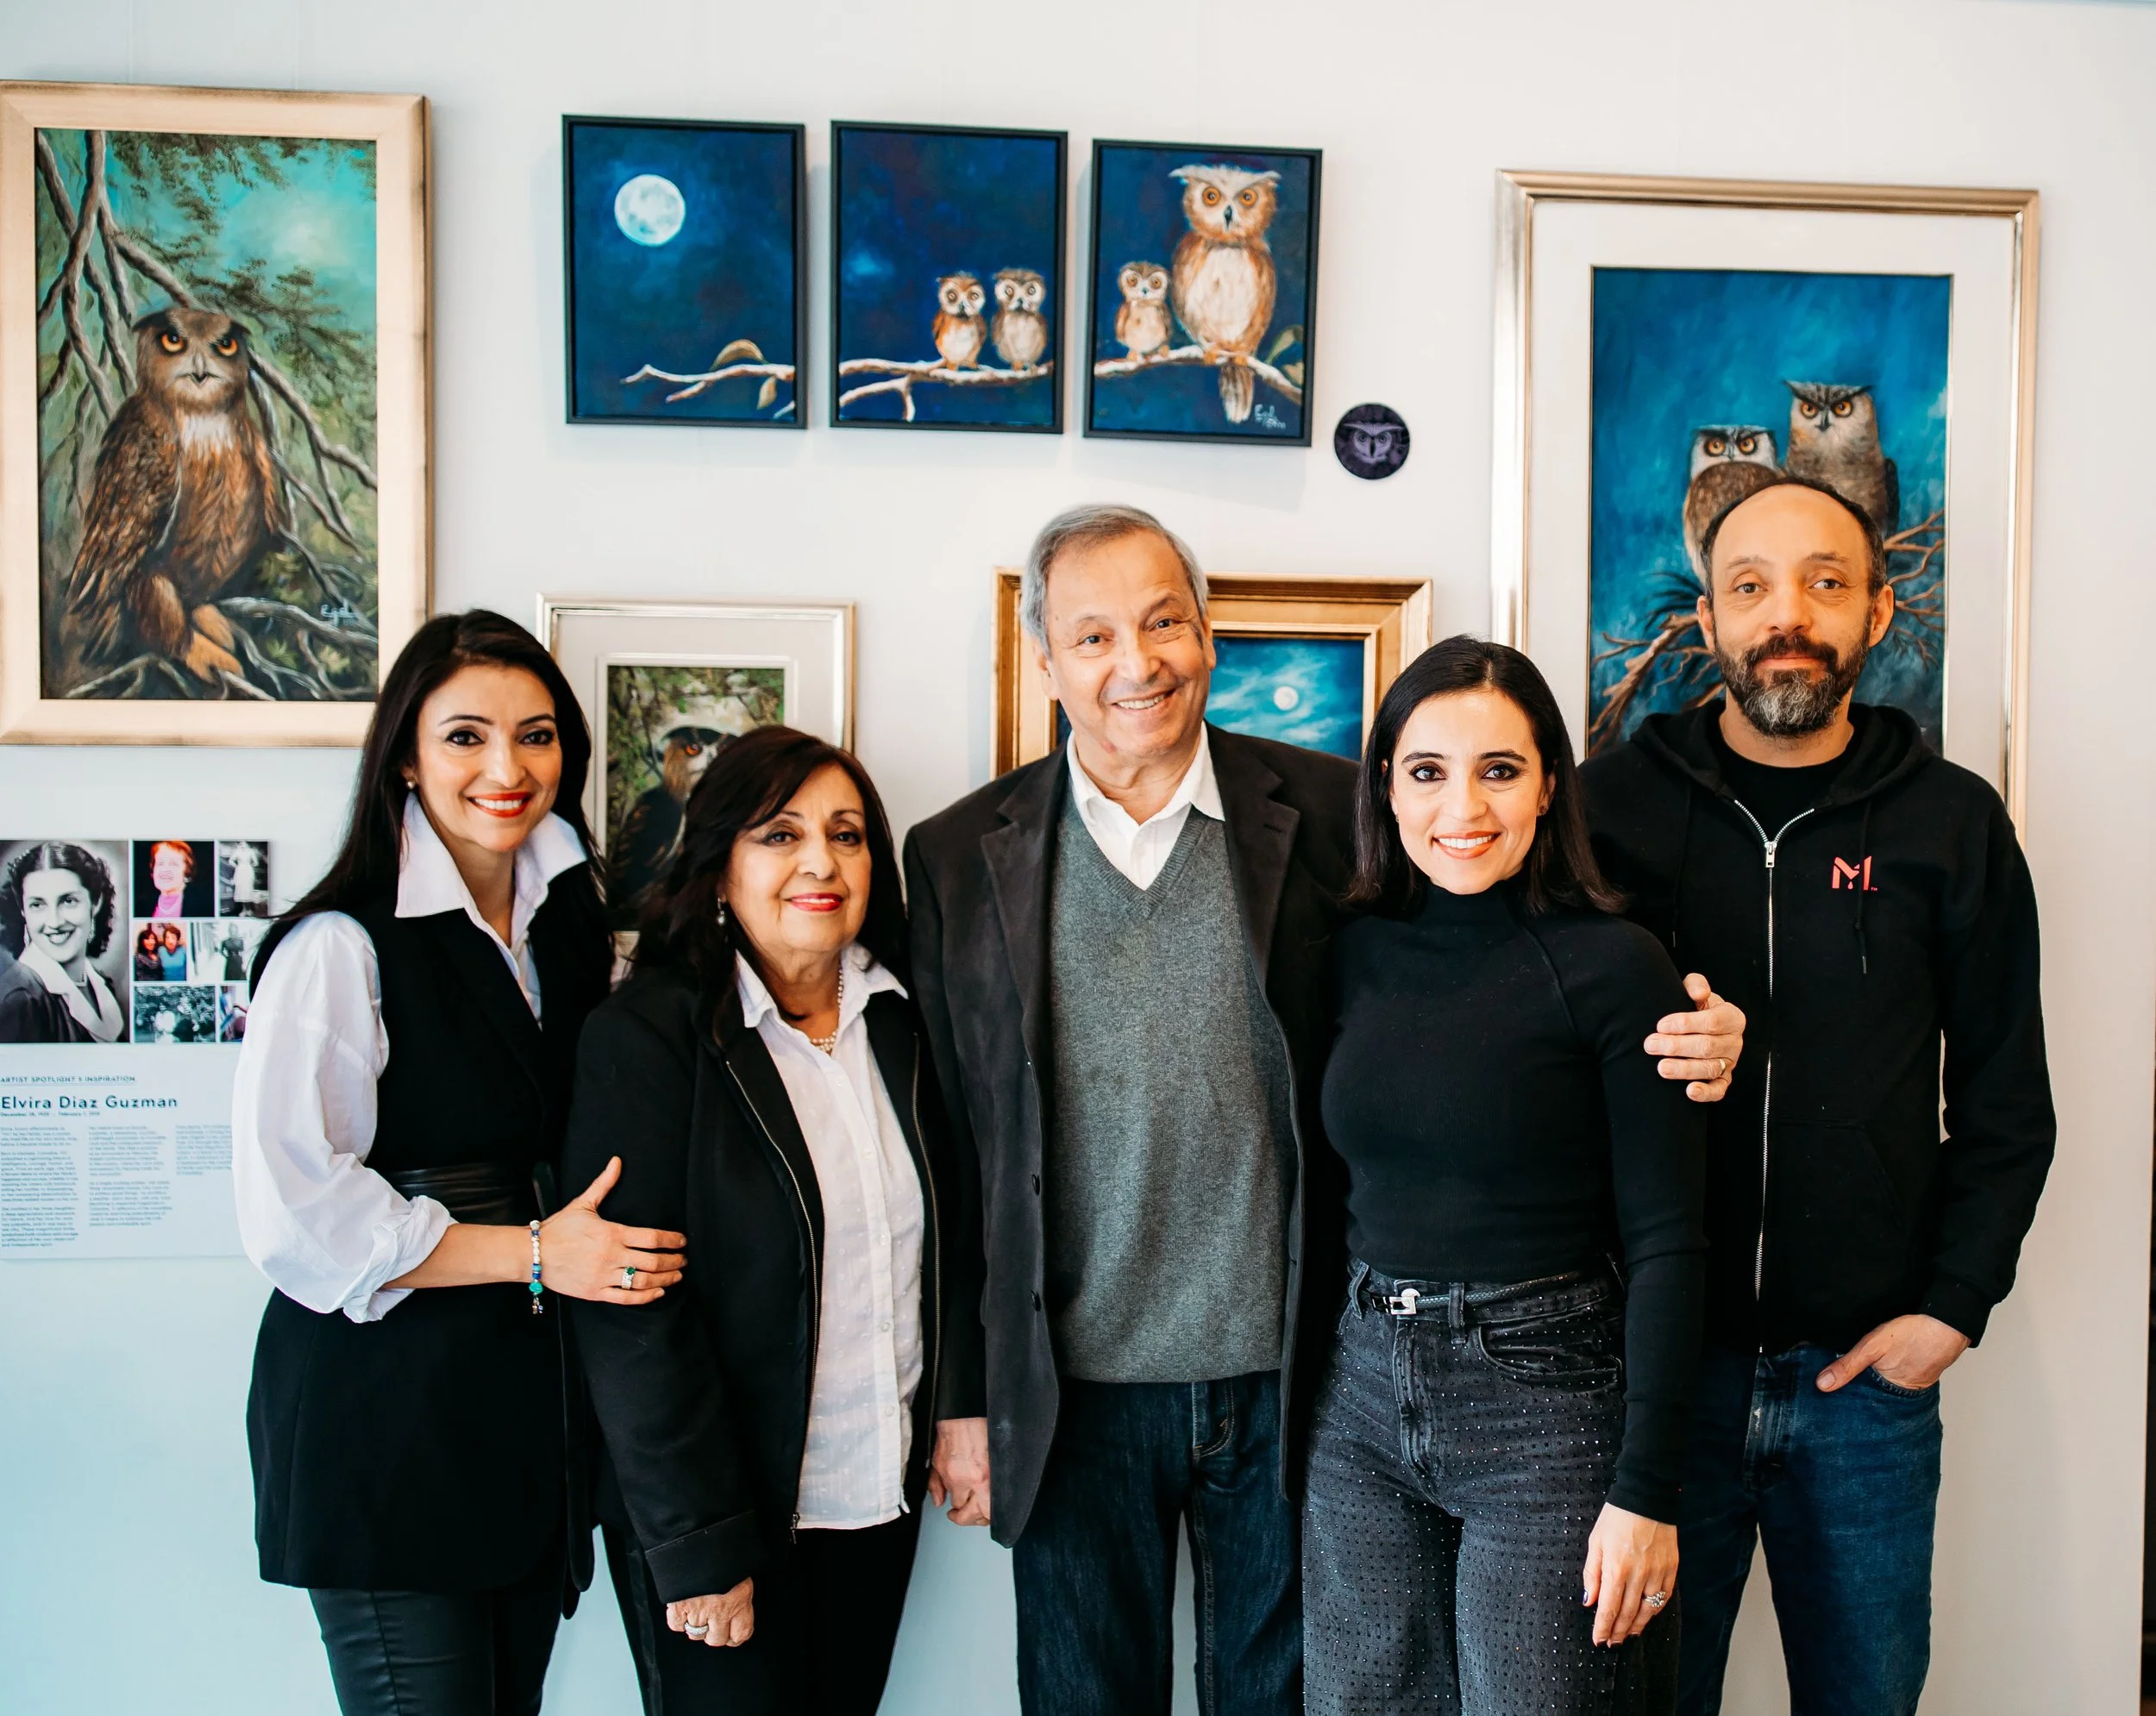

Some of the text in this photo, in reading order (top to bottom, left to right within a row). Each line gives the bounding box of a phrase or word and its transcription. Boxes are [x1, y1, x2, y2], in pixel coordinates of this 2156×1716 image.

[2, 1094, 177, 1108] Elvira Diaz Guzman
